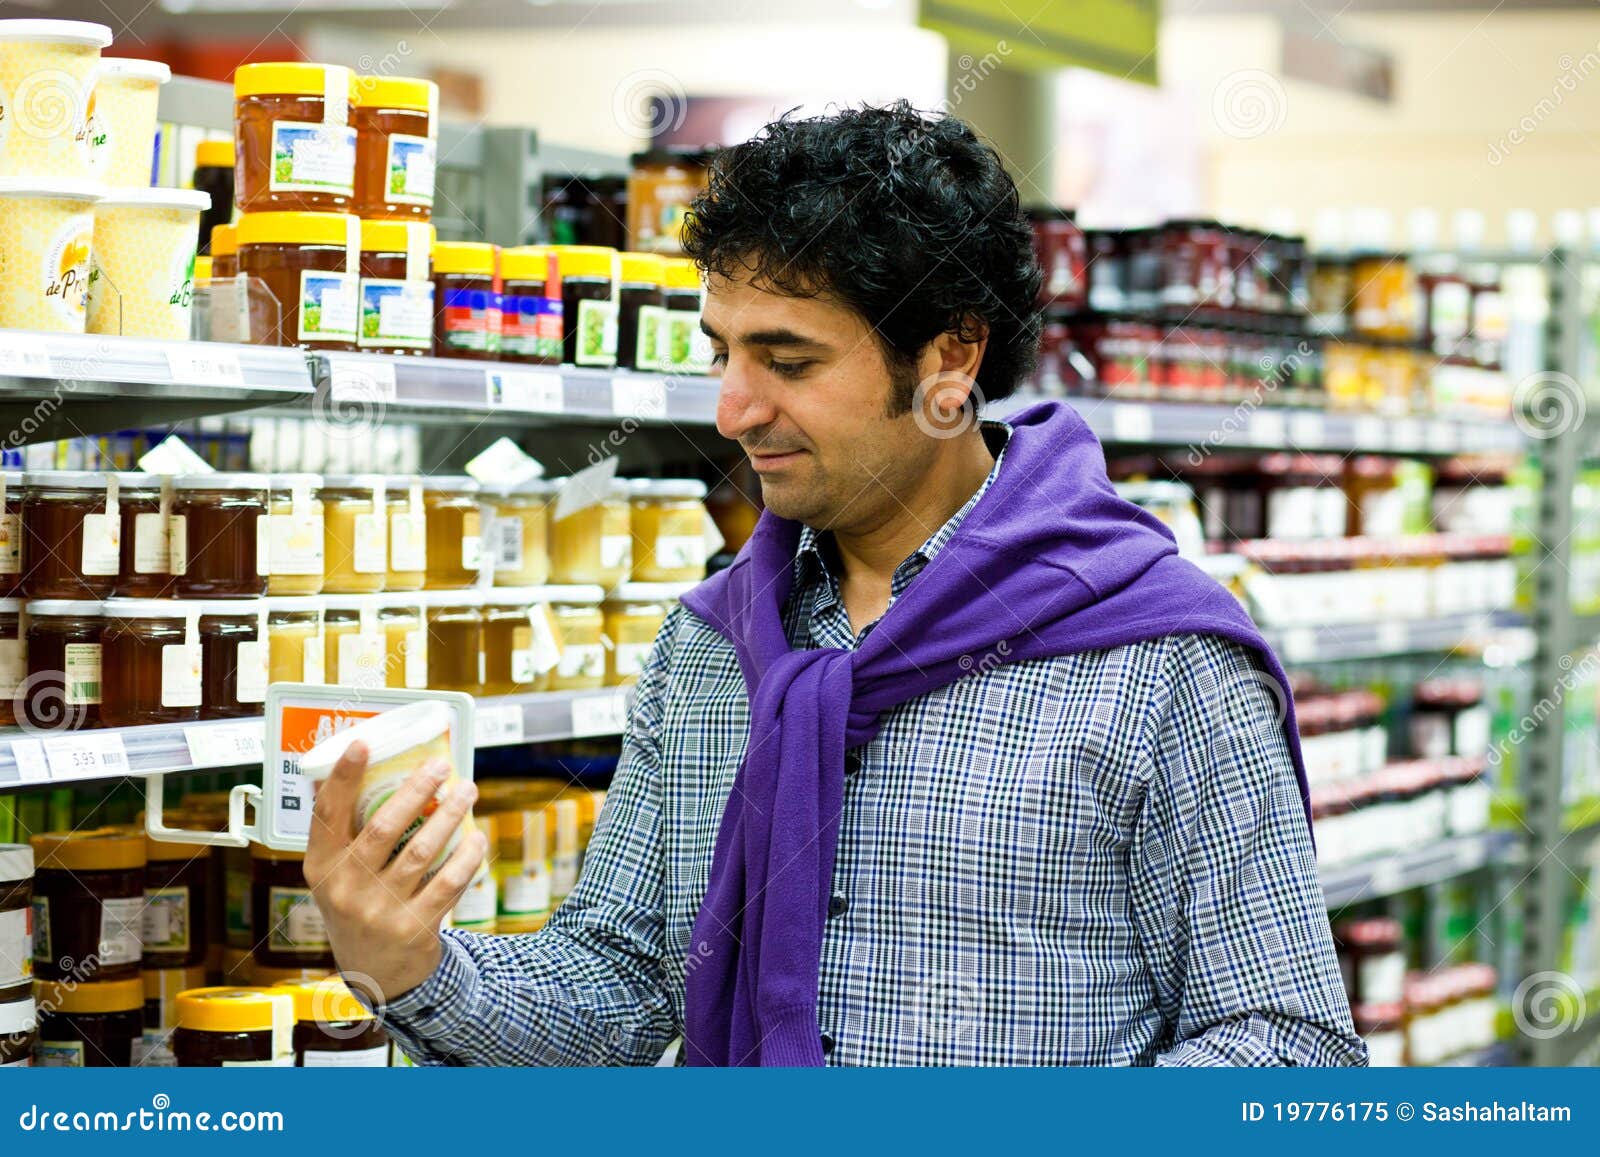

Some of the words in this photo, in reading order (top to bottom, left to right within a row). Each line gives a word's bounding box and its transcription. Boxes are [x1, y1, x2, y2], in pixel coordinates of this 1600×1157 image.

[46, 281, 60, 296] de
[169, 290, 181, 304] de
[72, 752, 96, 767] 5.95
